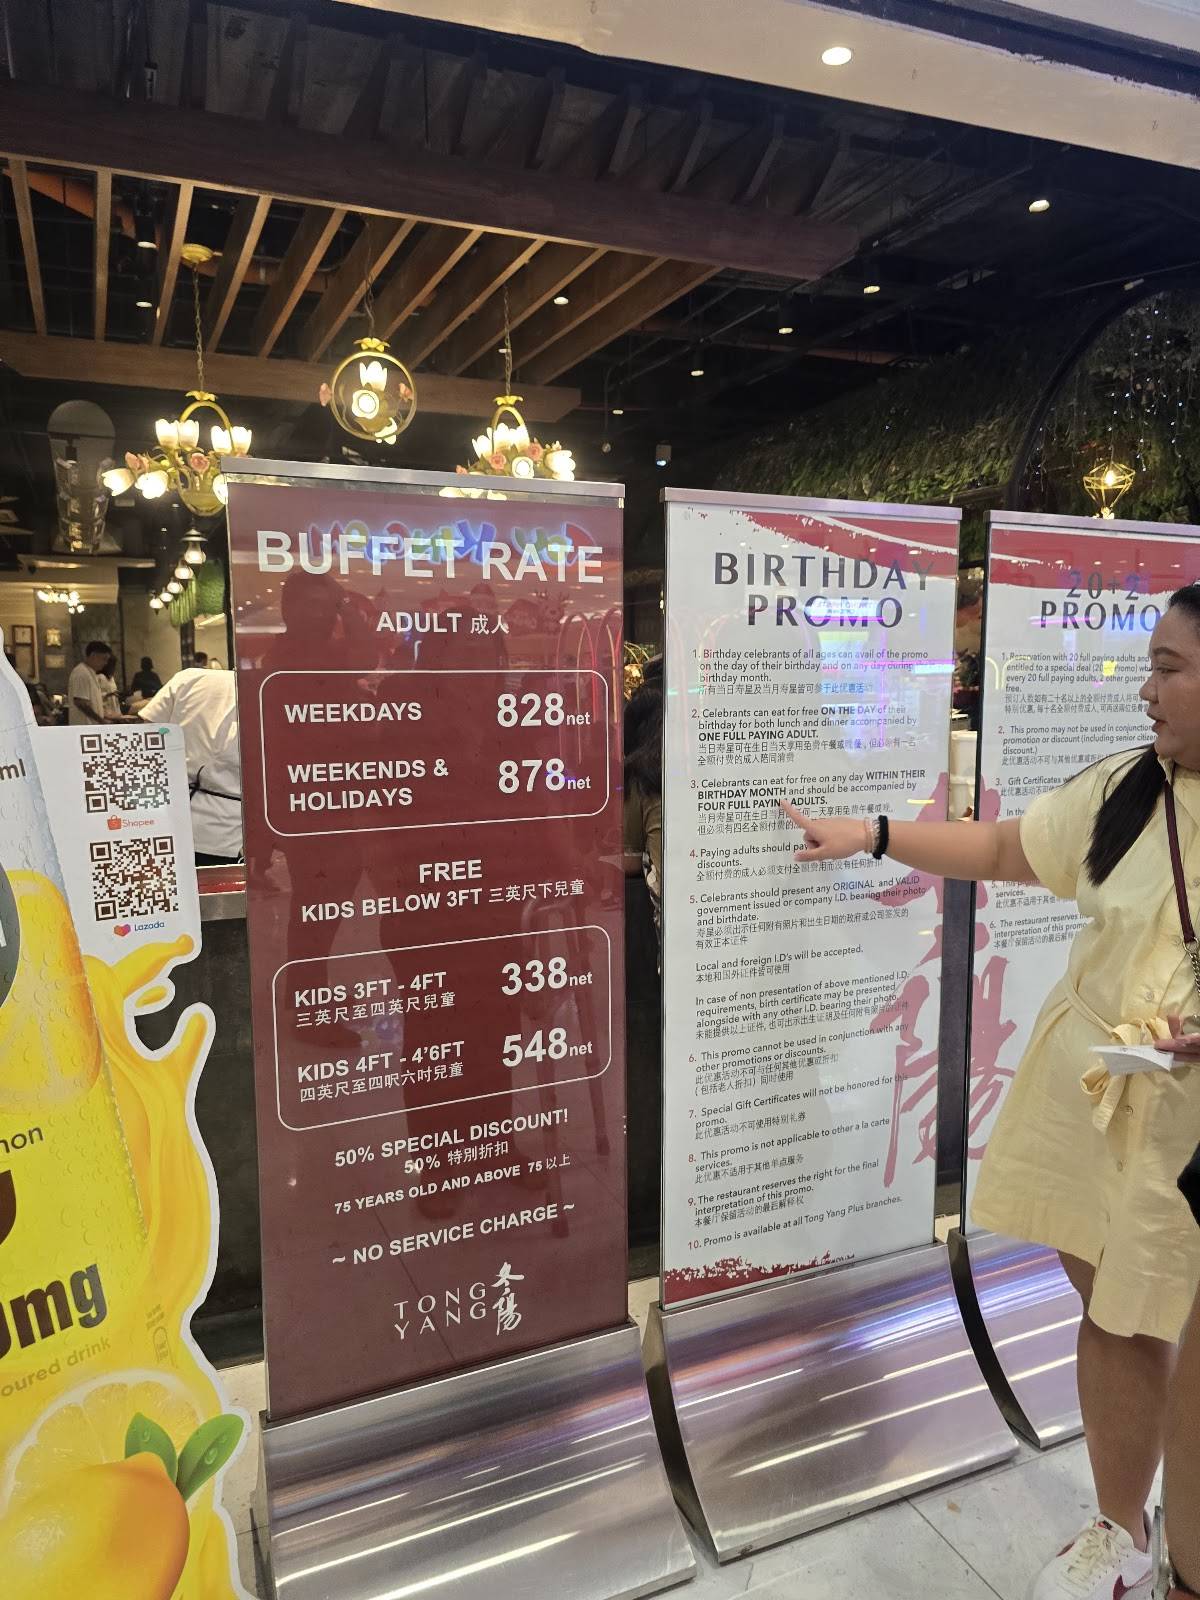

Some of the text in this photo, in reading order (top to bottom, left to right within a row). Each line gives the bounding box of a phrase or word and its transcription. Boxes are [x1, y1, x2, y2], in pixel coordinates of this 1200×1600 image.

[257, 530, 604, 584] BUFFET RATE
[715, 552, 933, 591] BIRTHDAY
[1067, 571, 1140, 600] 20+2
[376, 612, 509, 634] ADULT 成人
[748, 594, 903, 628] PROMO
[1040, 601, 1160, 631] PROMO
[285, 703, 421, 723] WEEKDAYS
[698, 729, 818, 742] ONE FULL PAYING ADULT.
[288, 759, 448, 783] WEEKENDS &
[689, 779, 700, 789] 3.
[699, 777, 750, 788] Celebrants
[750, 778, 767, 786] can
[769, 776, 784, 785] eat
[785, 774, 798, 784] for
[799, 773, 816, 783] free
[831, 774, 846, 784] any
[848, 771, 863, 783] day
[865, 769, 898, 780] WITHIN
[899, 768, 925, 778] THEIR
[290, 788, 413, 812] HOLIDAYS
[697, 779, 916, 799] BIRTHDAY MONTH and should be accompanied by
[697, 796, 827, 811] FOUR FULL PAYIN ADULTS.
[122, 818, 154, 828] Shopee
[419, 860, 482, 883] FREE
[302, 879, 584, 922] KIDS BELOW 3FT 三英尺下兒童
[134, 920, 165, 932] Lazada
[696, 912, 760, 926] and birthdate.
[695, 959, 718, 971] Local
[721, 957, 738, 968] and
[740, 954, 771, 966] foreign
[794, 949, 808, 960] will
[810, 948, 823, 958] be
[823, 943, 863, 957] accepted.
[295, 986, 347, 1008] KIDS
[354, 979, 391, 999] 3FT
[410, 971, 447, 992] 4FT
[695, 996, 704, 1005] In
[706, 995, 726, 1004] case
[728, 991, 738, 1001] of
[740, 991, 758, 999] non
[757, 982, 812, 1000] presentation
[813, 980, 822, 990] of
[823, 978, 849, 989] above
[851, 970, 895, 985] mentioned
[296, 991, 456, 1028] 三英尺至四英尺兒童
[298, 1059, 349, 1082] KIDS
[356, 1052, 393, 1073] 4FT
[695, 1061, 720, 1072] other
[721, 1054, 772, 1071] promotions
[784, 1046, 825, 1059] discounts.
[301, 1062, 464, 1102] 四英尺至四呎六吋兒童
[335, 1109, 568, 1168] 50% SPECIAL DISCOUNT!
[404, 1141, 509, 1174] 50% 特別折扣
[335, 1154, 570, 1215] 75 YEARS OLD AND ABOVE 75 以上
[695, 1186, 813, 1215] interpretation of this promo.
[353, 1244, 383, 1265] NO
[389, 1223, 474, 1256] SERVICE
[480, 1204, 558, 1234] CHARGE
[687, 1239, 701, 1250] 10.
[703, 1234, 732, 1246] Promo
[734, 1230, 741, 1239] is
[741, 1221, 780, 1237] available
[782, 1219, 791, 1228] at
[792, 1215, 802, 1226] all
[803, 1213, 824, 1223] Tong
[825, 1208, 846, 1218] Yang
[846, 1203, 864, 1213] Plus
[394, 1283, 486, 1320] TONG
[395, 1304, 487, 1340] YANG
[67, 1336, 111, 1366] drink
